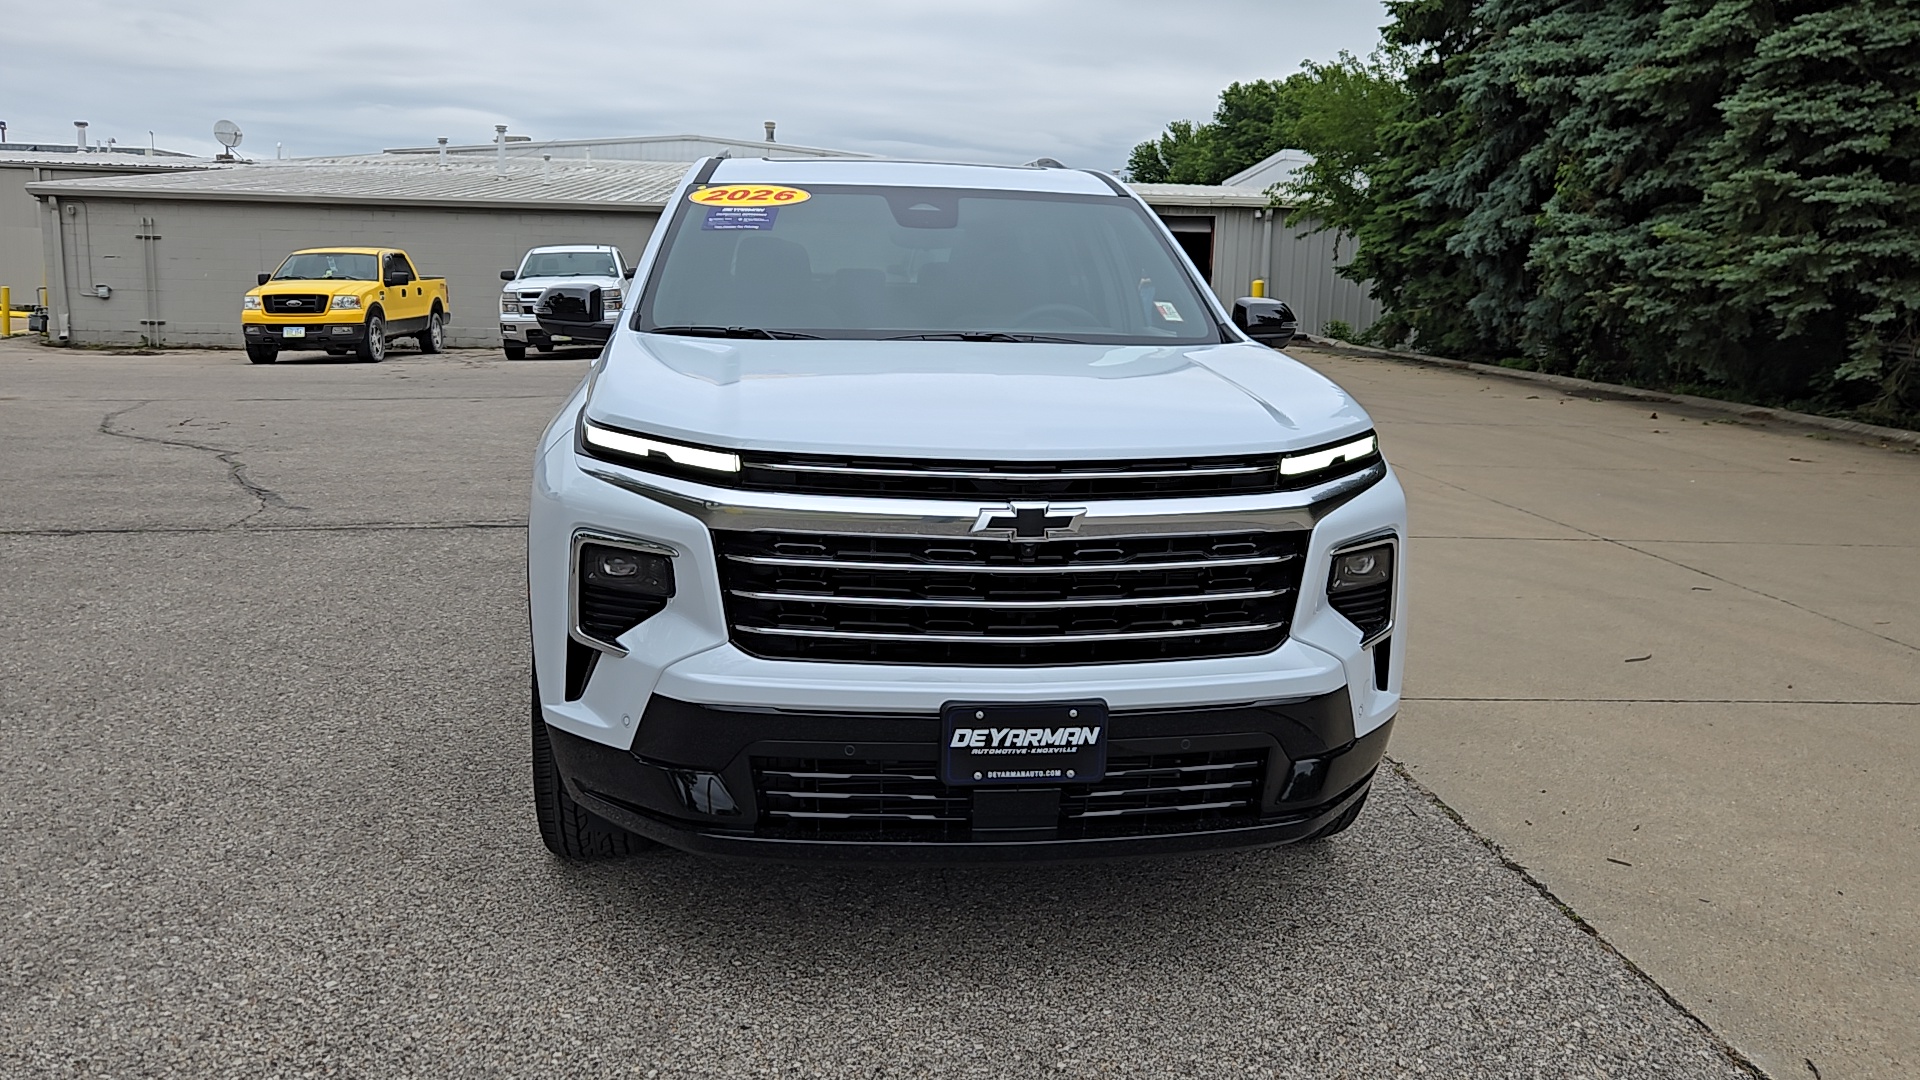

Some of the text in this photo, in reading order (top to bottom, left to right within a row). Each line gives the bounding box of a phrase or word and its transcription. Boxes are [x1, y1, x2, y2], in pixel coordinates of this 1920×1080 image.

[701, 189, 798, 201] 2026
[949, 726, 1101, 748] DEYARMAN
[987, 769, 1062, 779] DEYARMANAUTO.COM
